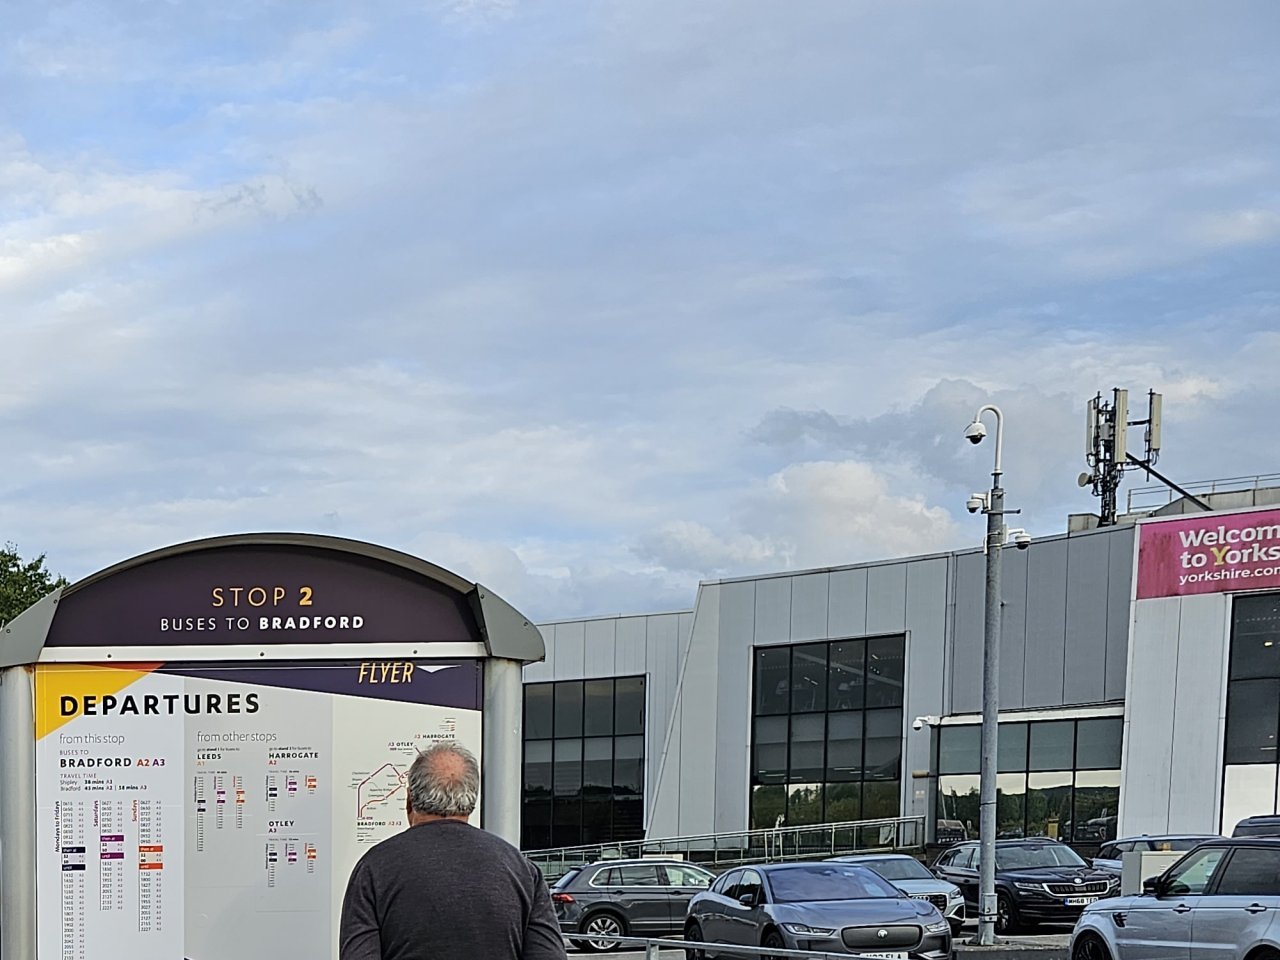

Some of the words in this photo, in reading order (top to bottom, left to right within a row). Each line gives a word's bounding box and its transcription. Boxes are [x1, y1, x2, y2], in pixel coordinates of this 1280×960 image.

[1180, 551, 1207, 568] to
[212, 587, 285, 607] STOP
[299, 587, 313, 606] 2
[160, 617, 216, 631] BUSES
[226, 617, 250, 630] TO
[259, 616, 364, 630] BRADFORD
[358, 662, 414, 684] FLYER
[60, 693, 260, 716] DEPARTURES
[60, 733, 82, 744] from
[85, 733, 102, 744] this
[104, 734, 125, 745] stop
[198, 731, 221, 742] from
[223, 731, 249, 742] other
[251, 732, 277, 743] stops
[60, 758, 132, 768] BRADFORD
[137, 759, 150, 767] A2
[152, 759, 166, 767] A3
